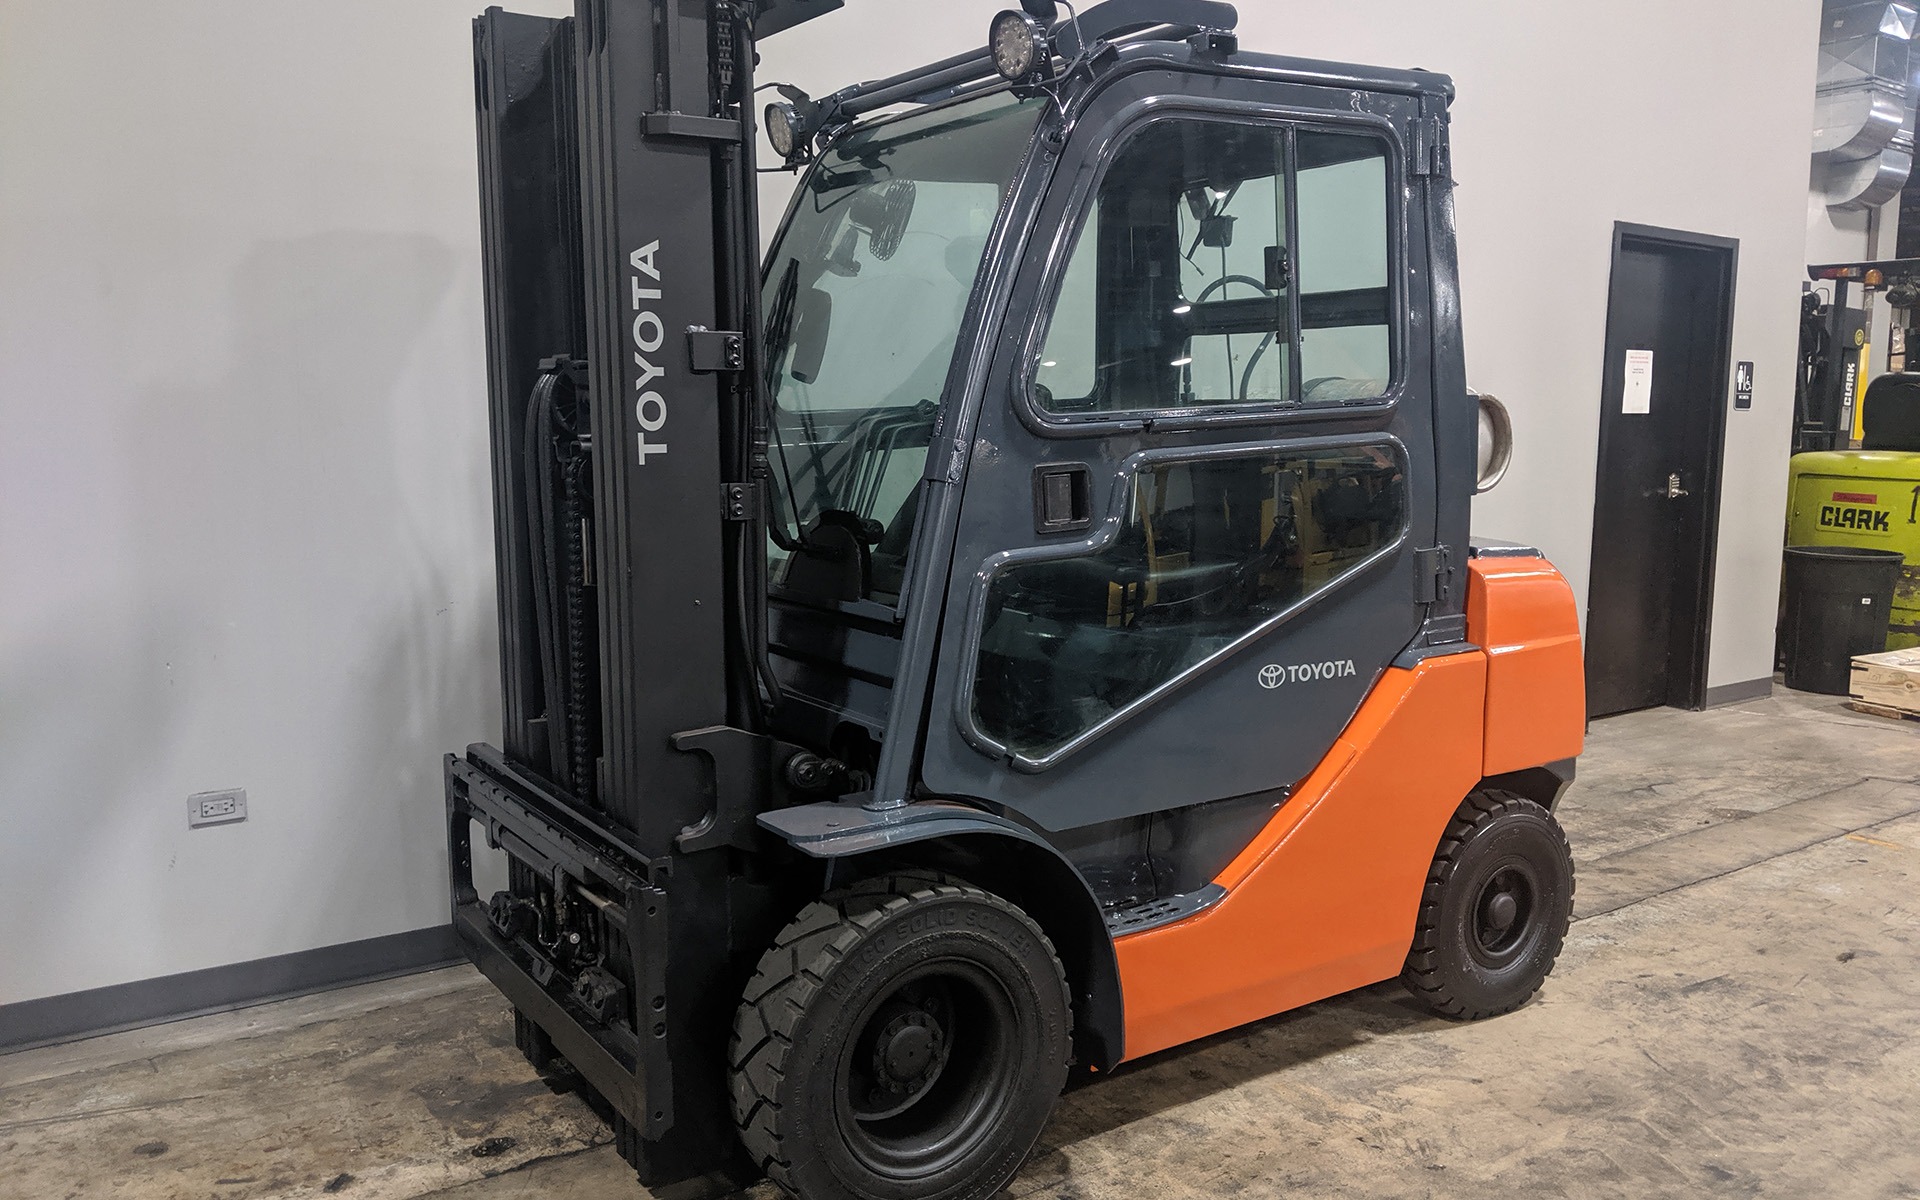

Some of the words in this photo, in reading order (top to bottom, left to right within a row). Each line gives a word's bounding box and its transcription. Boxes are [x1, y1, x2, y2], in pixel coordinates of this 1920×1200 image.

[630, 239, 667, 465] TOYOTA
[1843, 362, 1856, 406] CLARK
[1820, 505, 1890, 532] CLARK
[1288, 659, 1356, 683] TOYOTA
[896, 907, 958, 939] SOLID
